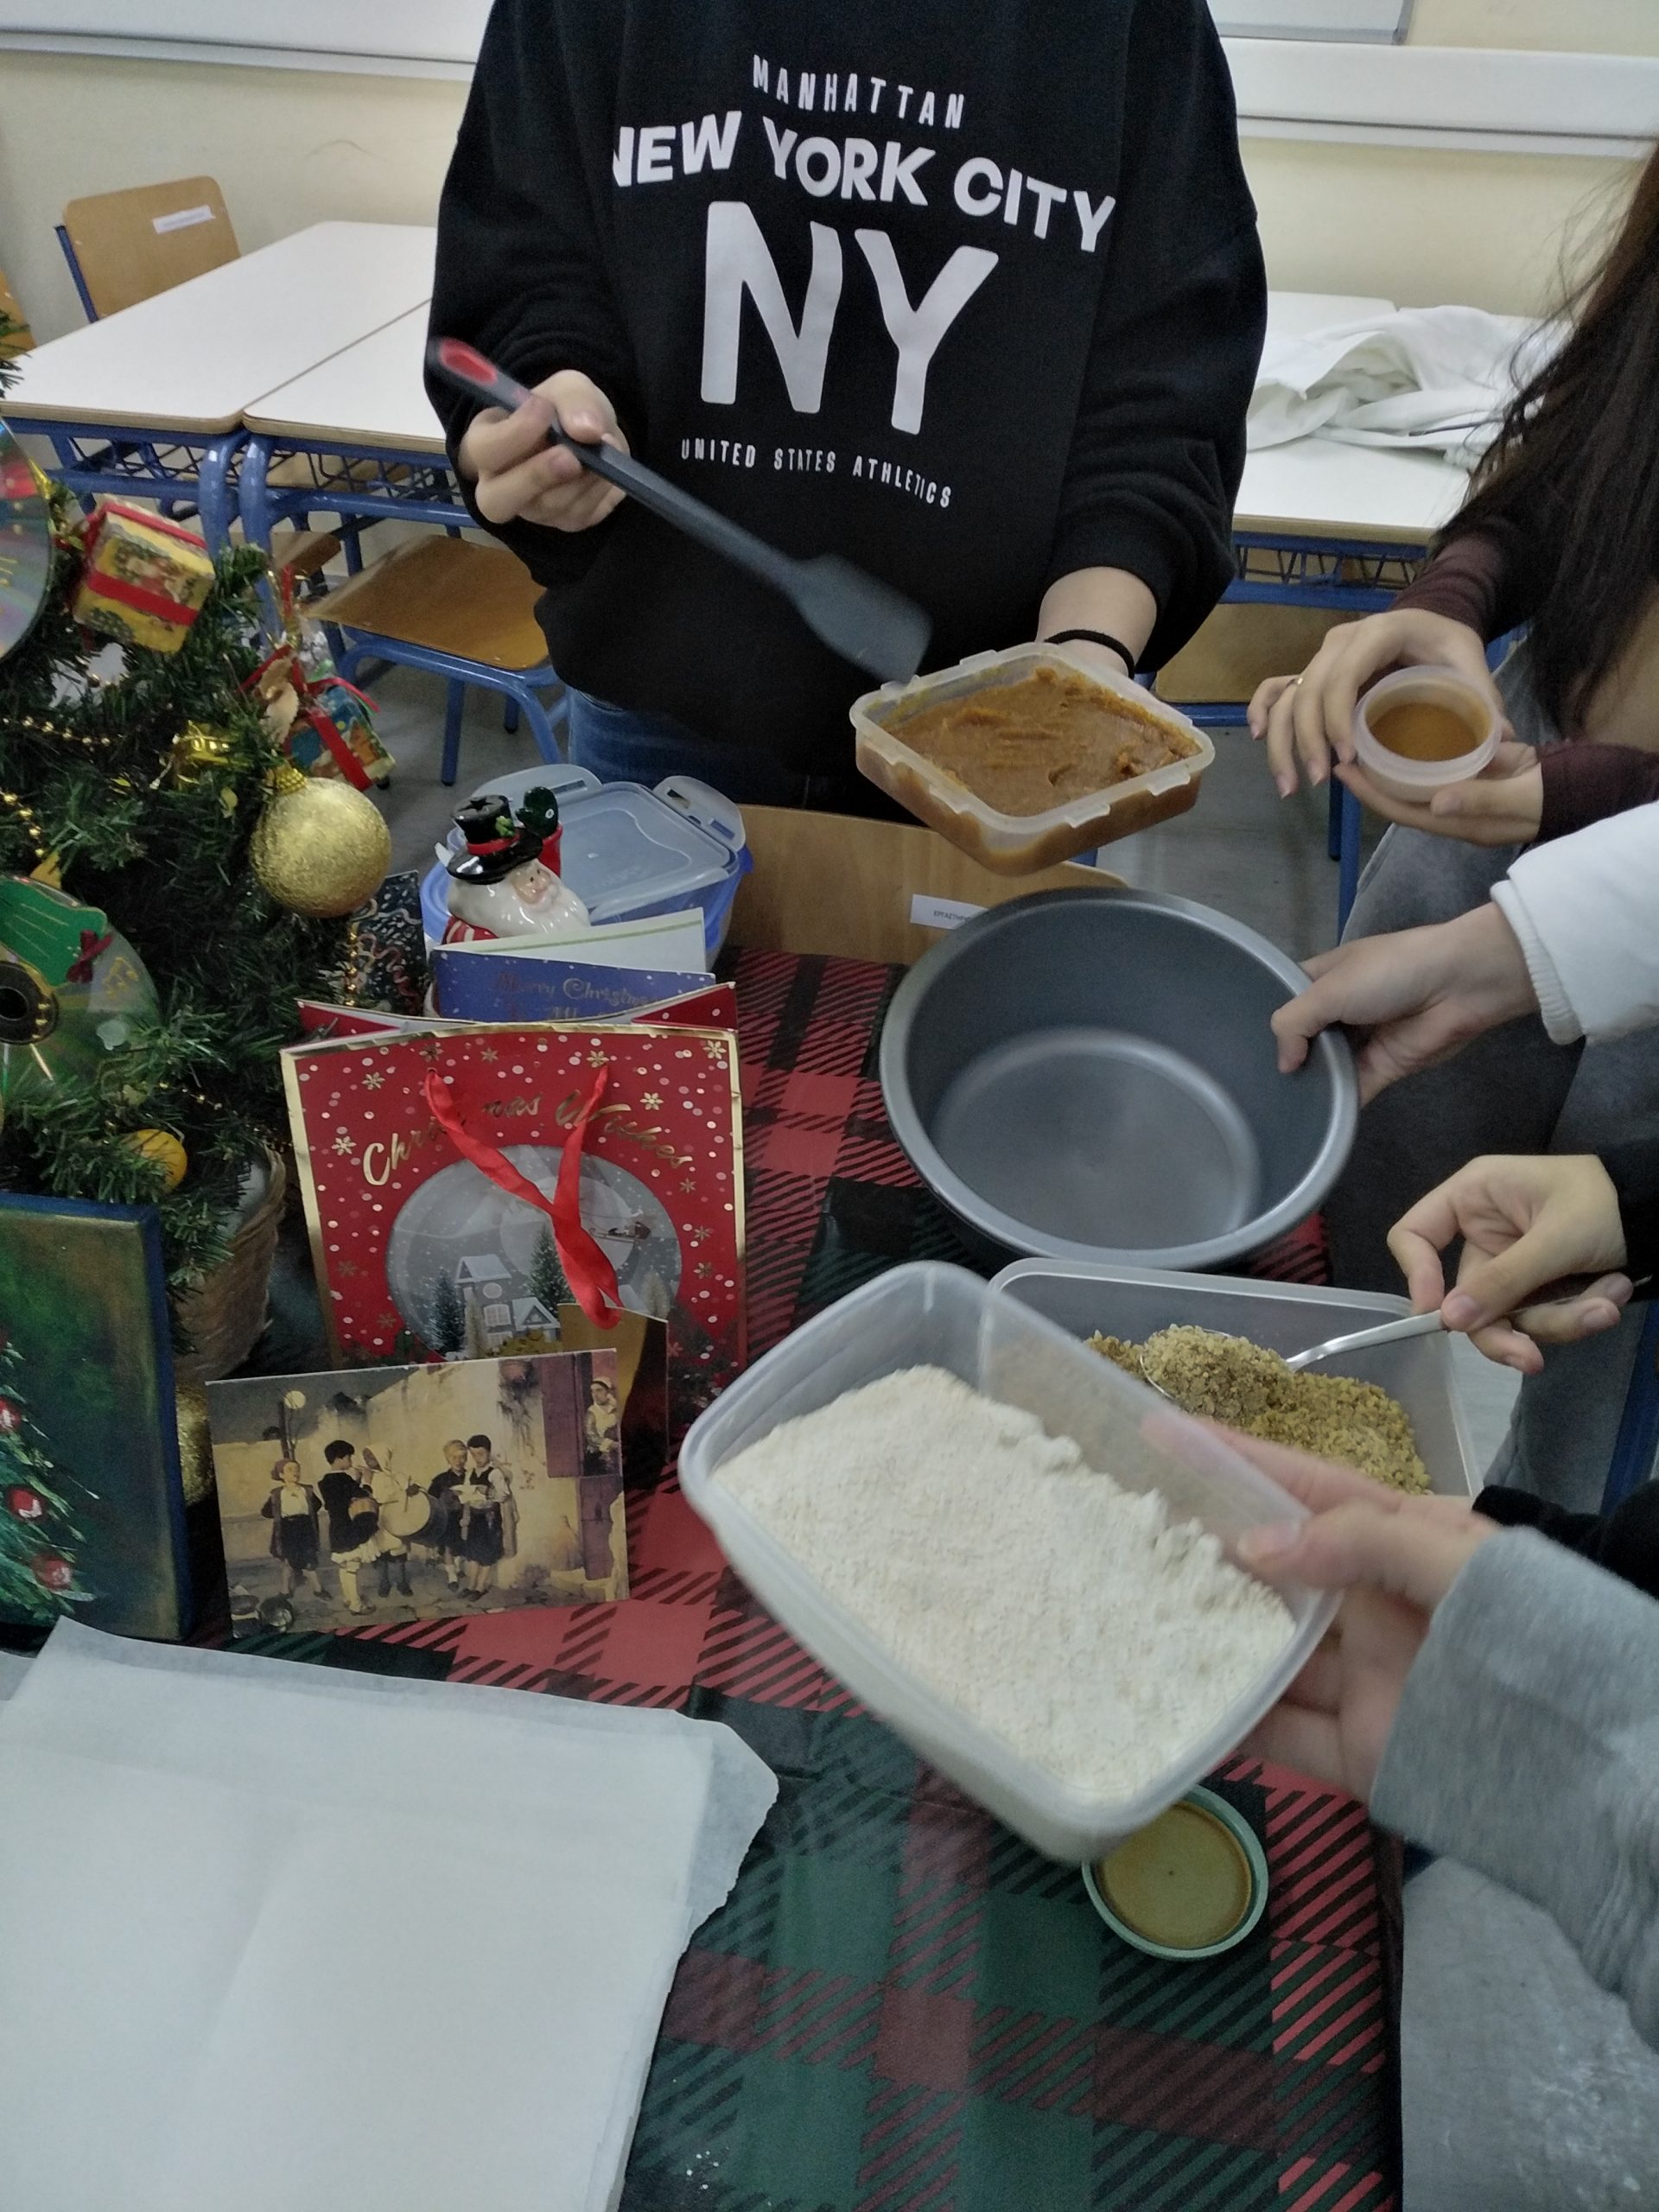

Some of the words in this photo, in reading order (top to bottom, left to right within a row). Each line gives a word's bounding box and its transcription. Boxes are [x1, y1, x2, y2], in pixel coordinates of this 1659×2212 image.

[753, 54, 965, 129] MANHATTAN
[613, 110, 743, 188] NEW
[762, 116, 936, 206] YORK
[953, 156, 1116, 253] CITY
[700, 200, 1000, 435] NY
[681, 437, 757, 469] UNITED
[773, 448, 836, 474] STATES
[852, 455, 952, 508] ATHLETICS
